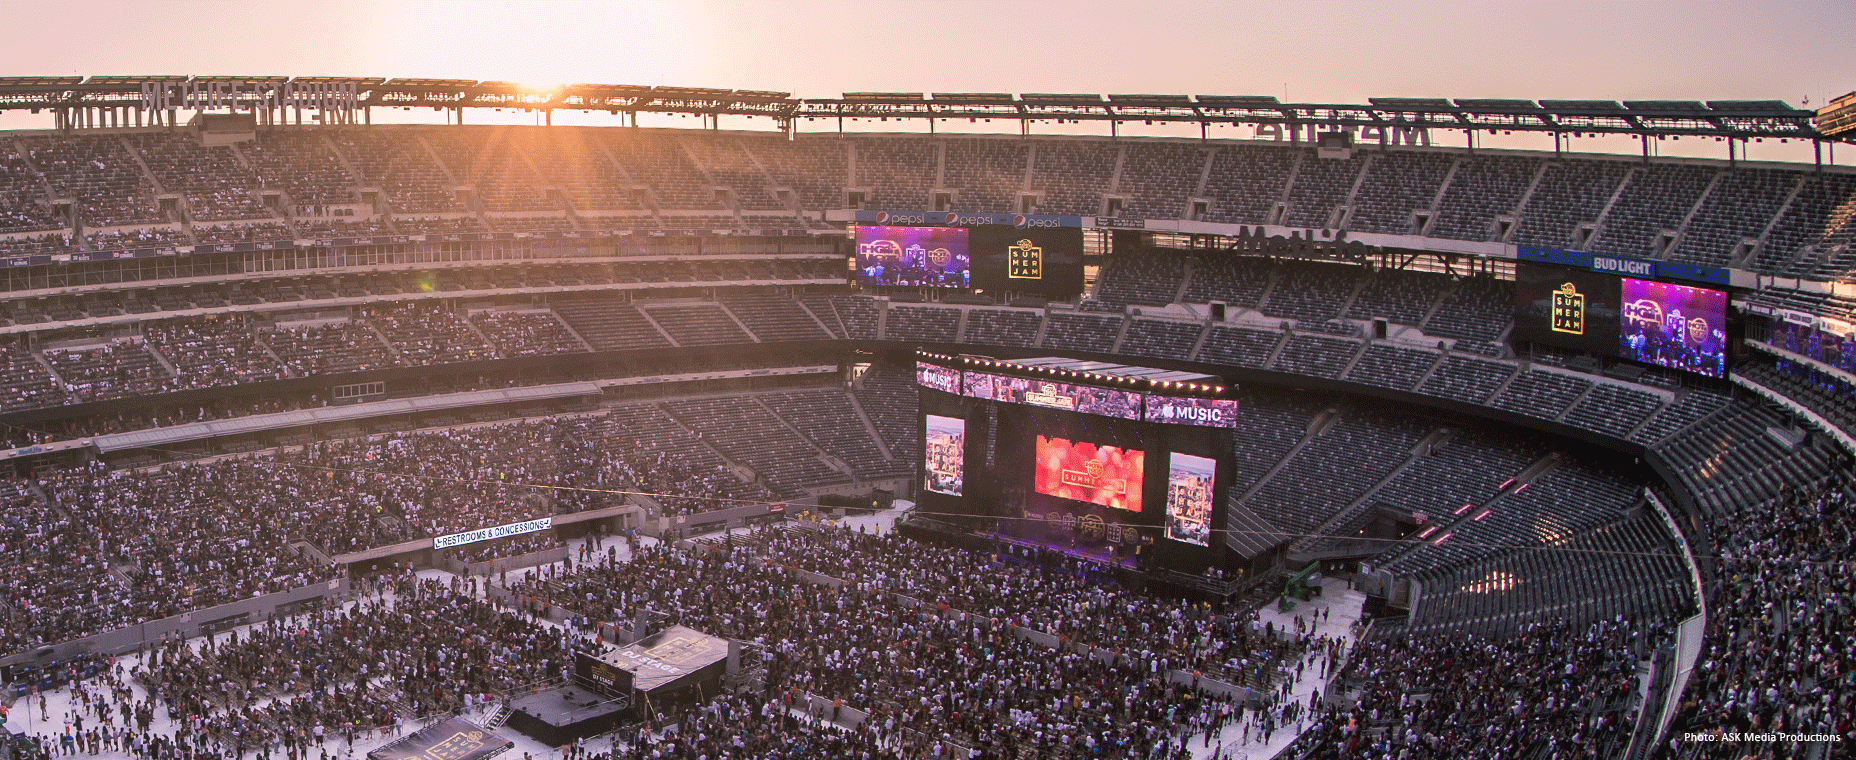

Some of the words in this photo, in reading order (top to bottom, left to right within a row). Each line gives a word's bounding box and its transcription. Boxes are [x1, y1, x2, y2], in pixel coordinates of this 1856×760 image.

[141, 81, 246, 110] METLIFE
[254, 81, 358, 110] STADIUM
[891, 213, 925, 225] pepsi
[959, 215, 994, 227] pepsi
[1027, 217, 1061, 229] pepsi
[1238, 226, 1366, 262] MetLife
[1594, 257, 1617, 271] BUD
[1618, 259, 1652, 275] LIGHT
[929, 373, 952, 388] MUSIC
[1176, 407, 1222, 421] MUSIC
[442, 530, 486, 546] RESTROOMS
[494, 520, 545, 537] CONCESSIONS
[622, 651, 641, 659] DJ
[639, 657, 681, 674] STAGE
